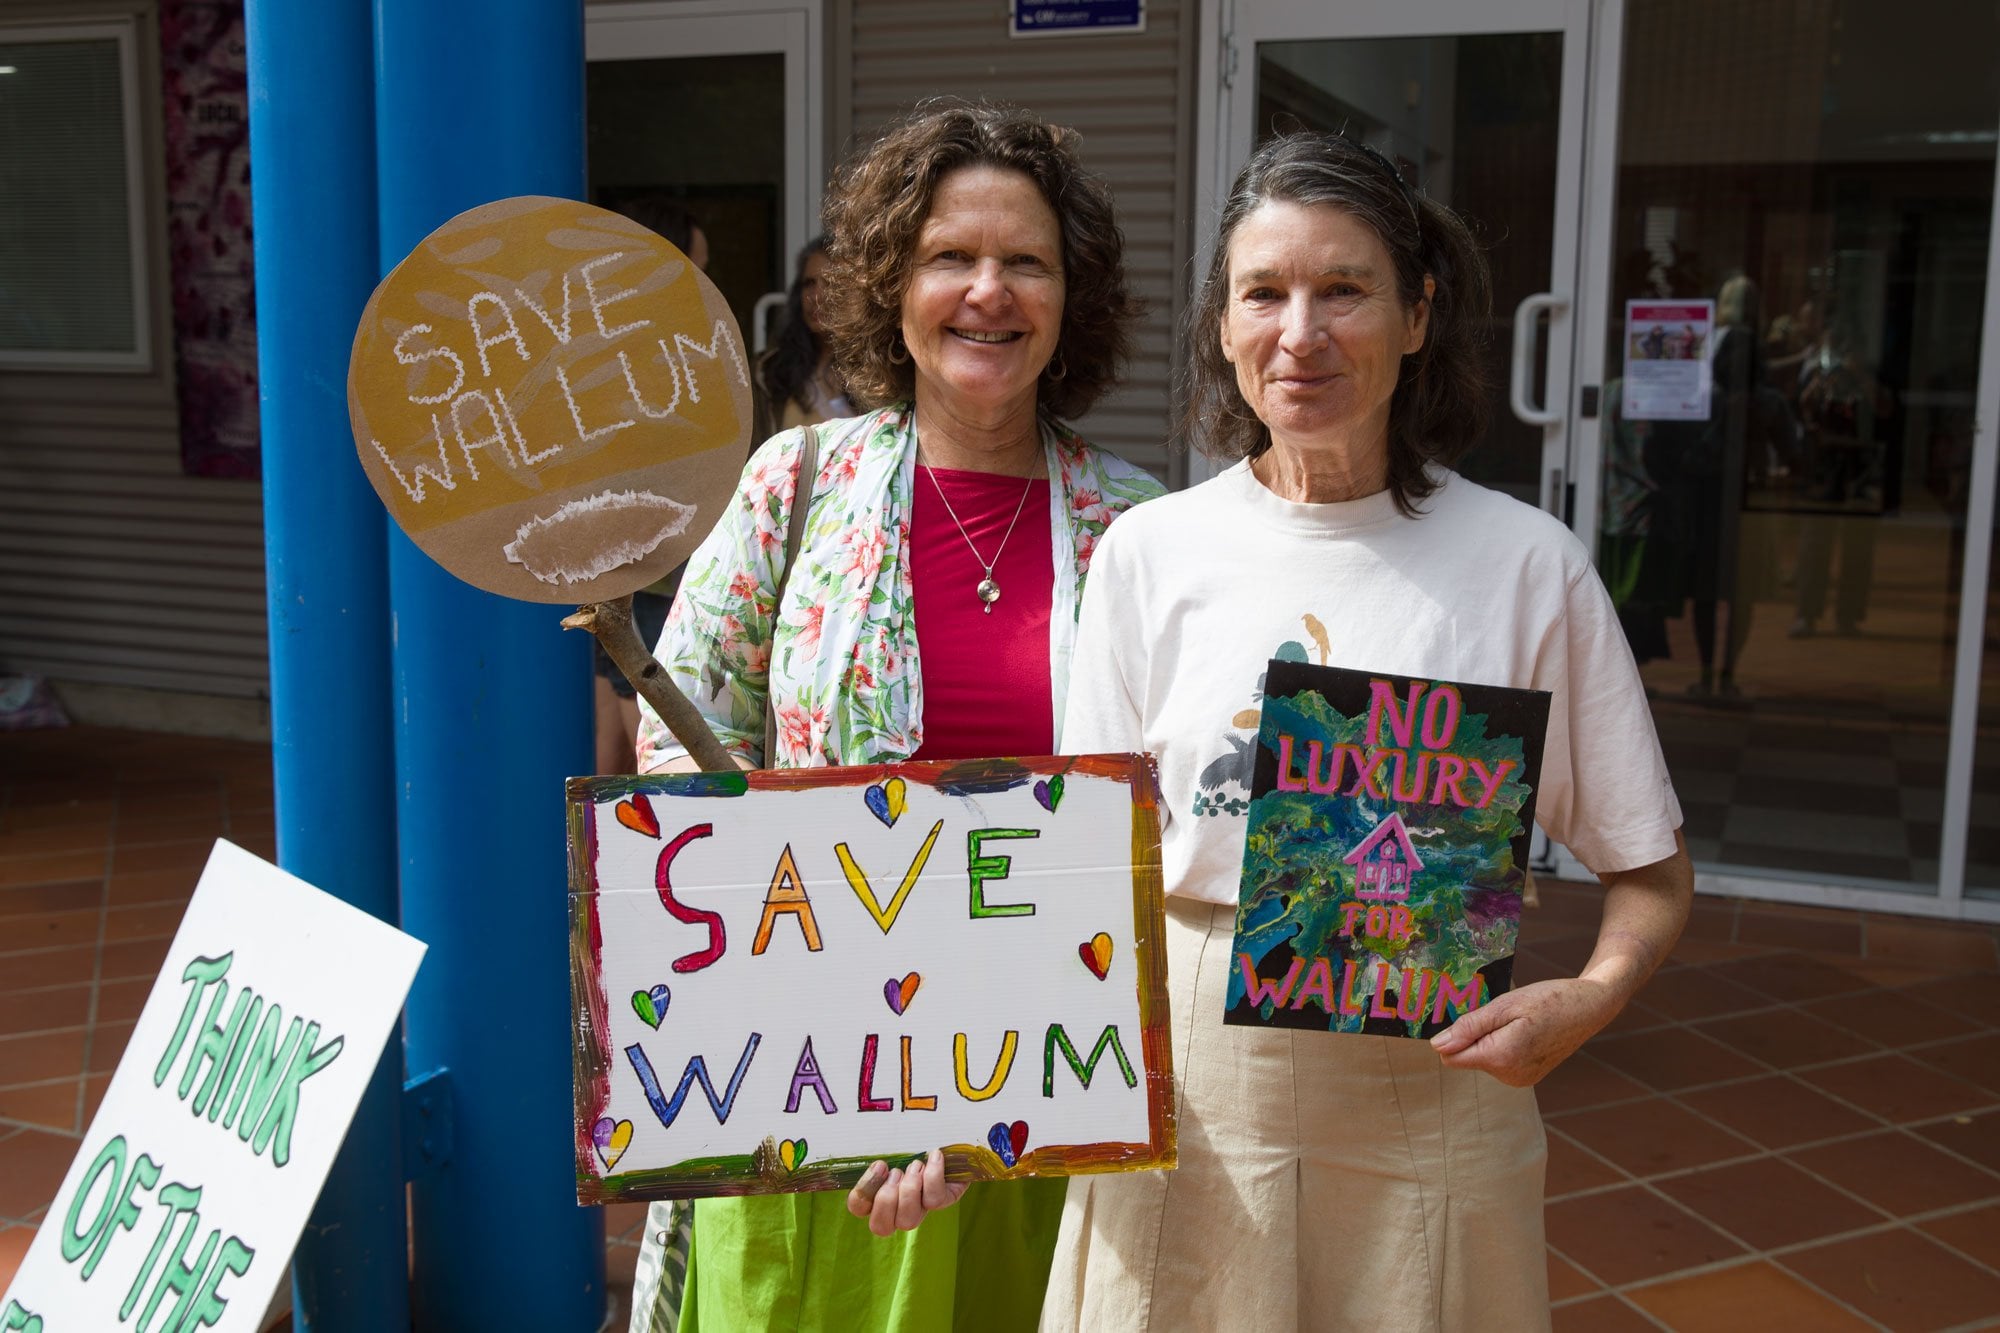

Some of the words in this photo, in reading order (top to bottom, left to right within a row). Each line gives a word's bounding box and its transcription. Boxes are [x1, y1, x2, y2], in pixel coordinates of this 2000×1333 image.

[394, 252, 651, 404] SAVE
[371, 319, 749, 503] WALLUM
[1277, 735, 1517, 808] LUXURY
[1363, 678, 1462, 750] NO
[655, 819, 1041, 973] SAVE
[1339, 902, 1415, 940] FOR
[1238, 953, 1485, 1024] WALLUM
[154, 951, 344, 1168] THINK
[624, 1023, 1138, 1129] WALLUM
[61, 1135, 164, 1282] OF
[119, 1182, 256, 1333] THE
